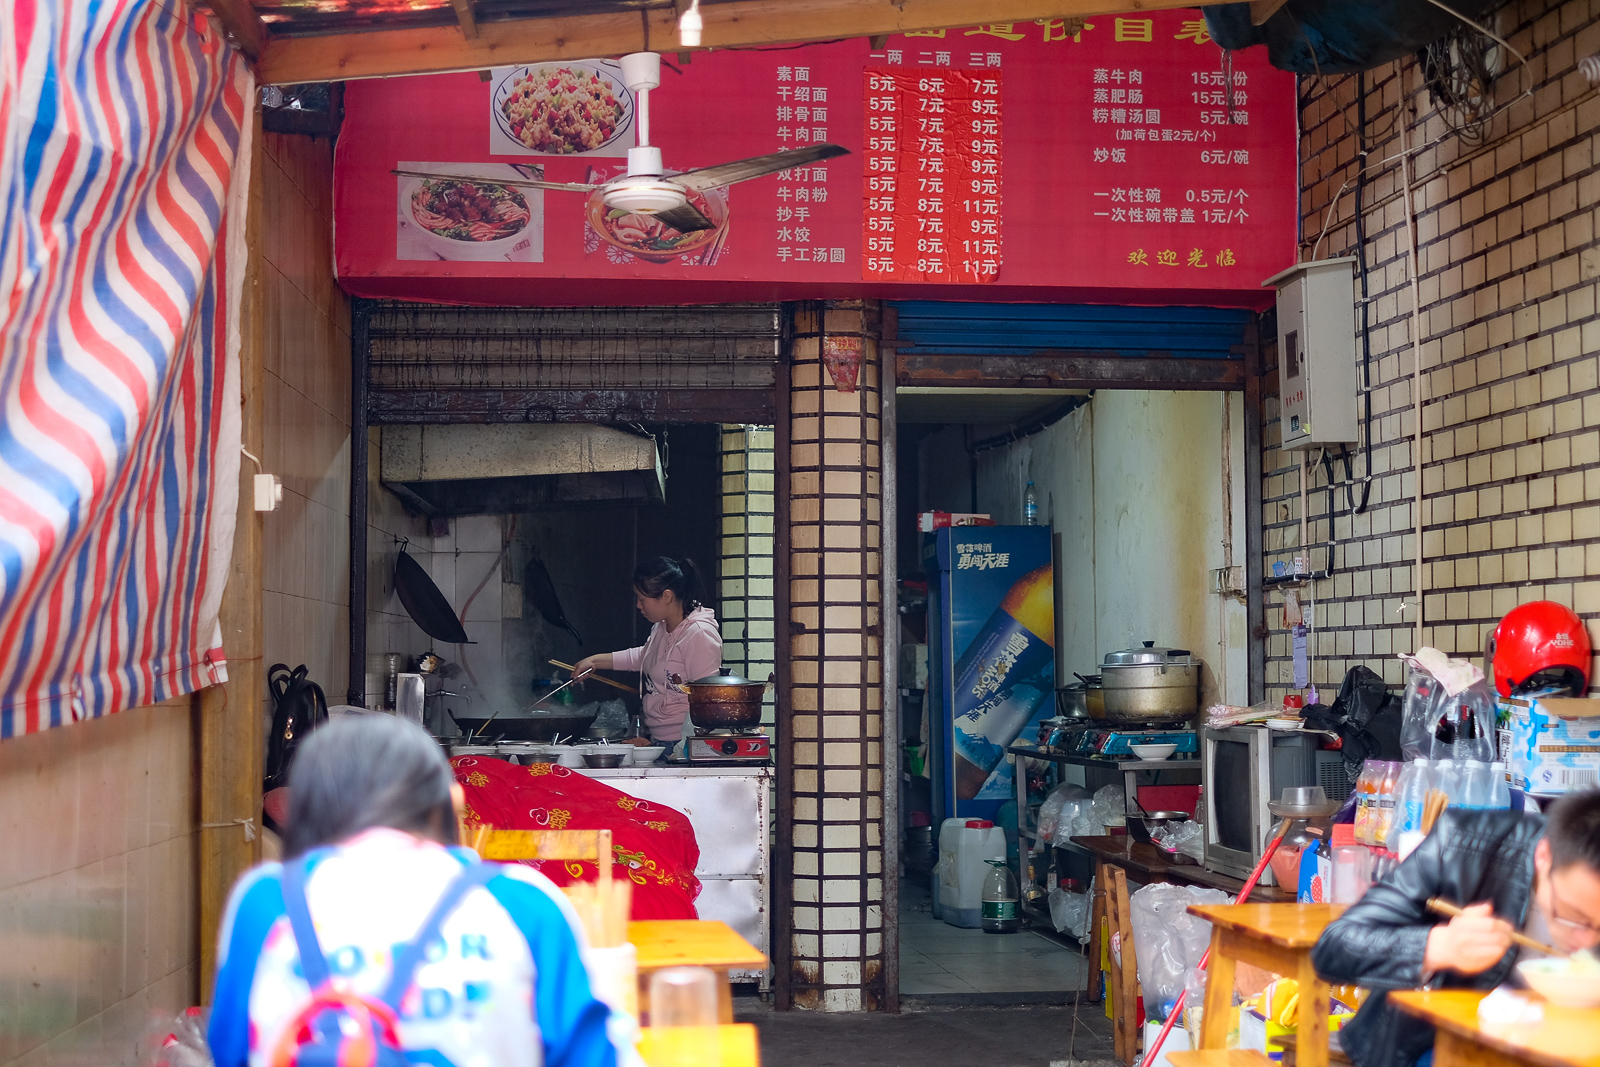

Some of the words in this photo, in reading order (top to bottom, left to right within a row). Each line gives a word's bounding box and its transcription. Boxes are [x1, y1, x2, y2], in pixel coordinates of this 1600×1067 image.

[870, 49, 902, 64] 一两
[918, 51, 951, 66] 二两
[968, 53, 1001, 67] 三两
[776, 66, 810, 81] 素面
[1093, 69, 1142, 84] 蒸牛肉
[1192, 71, 1248, 86] 15元份
[776, 86, 828, 102] 干绍面
[870, 77, 896, 91] 5元
[919, 78, 944, 93] 6元
[972, 80, 998, 94] 7元
[1093, 88, 1143, 104] 蒸肥肠
[1192, 91, 1248, 105] 15元份
[776, 106, 828, 122] 排骨面
[869, 97, 895, 111] 5元
[919, 99, 944, 113] 7元
[971, 100, 998, 114] 9元
[776, 126, 828, 142] 牛肉面
[869, 117, 895, 132] 5元
[919, 119, 944, 133] 7元
[971, 120, 998, 134] 9元
[1116, 129, 1216, 142] (加荷包蛋2元/个)
[869, 137, 895, 152] 5元
[919, 139, 944, 153] 7元
[971, 140, 998, 155] 9元
[1093, 148, 1127, 163] 炒饭
[1201, 150, 1249, 164] 6元/碗
[776, 167, 828, 182] 双打面
[869, 157, 895, 172] 5元
[918, 159, 944, 173] 7元
[971, 160, 998, 175] 9元
[776, 186, 828, 202] 牛肉粉
[869, 178, 895, 192] 5元
[918, 179, 944, 193] 7元
[971, 180, 997, 195] 9元
[1094, 188, 1161, 203] 一次性碗
[1186, 189, 1249, 204] 0.5元/个
[776, 206, 811, 222] 抄手
[869, 198, 895, 212] 5元
[918, 199, 944, 213] 8元
[963, 201, 997, 215] 11元
[1094, 208, 1196, 223] 一次性碗带盖
[1202, 209, 1249, 223] 1元/个
[776, 227, 811, 242] 水饺
[868, 218, 895, 232] 5元
[918, 219, 944, 234] 7元
[970, 221, 997, 235] 9元
[776, 247, 846, 263] 手工汤圆
[868, 238, 895, 252] 5元
[918, 239, 944, 254] 8元
[962, 241, 997, 255] 11元
[1127, 248, 1236, 267] 欢迎光临
[868, 258, 894, 272] 5元
[918, 259, 943, 274] 8元
[962, 261, 997, 275] 11元
[956, 543, 992, 553] 雪花啤酒
[957, 553, 1010, 570] 勇闯天涯
[971, 664, 998, 698] SNOW
